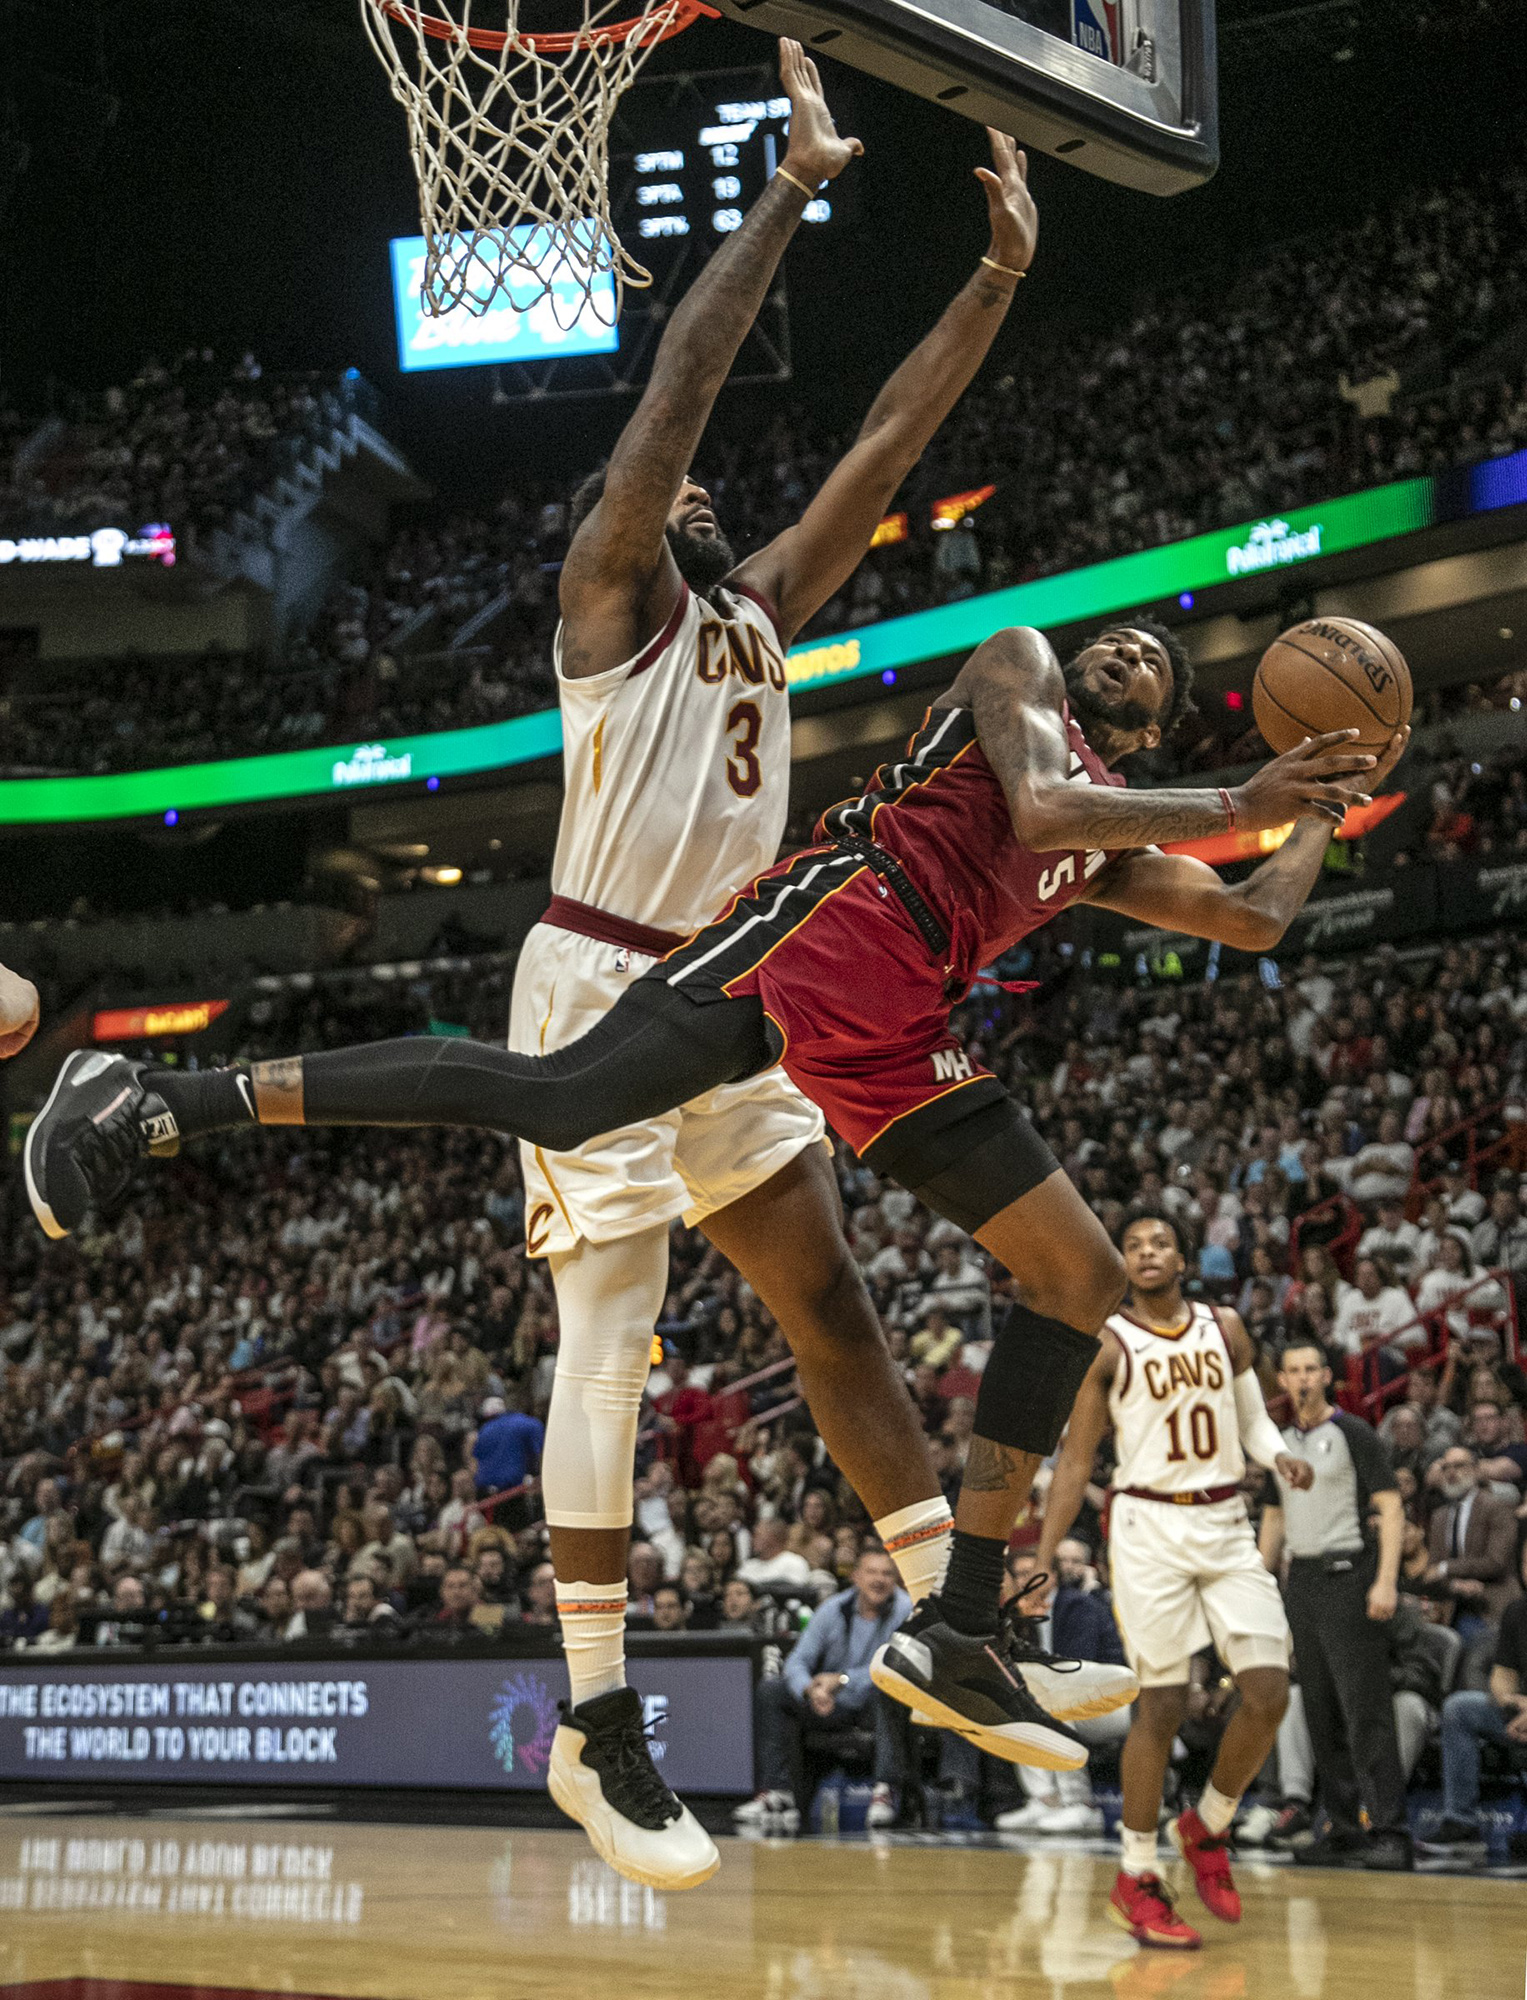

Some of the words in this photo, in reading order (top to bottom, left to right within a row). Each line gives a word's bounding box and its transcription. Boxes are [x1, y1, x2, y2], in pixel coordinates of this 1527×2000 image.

[1078, 20, 1104, 57] NBA
[726, 699, 764, 799] 3
[1037, 854, 1076, 902] 5
[529, 1202, 554, 1254] C
[1143, 1349, 1225, 1401] CAVS
[1165, 1402, 1219, 1462] 10
[0, 1683, 38, 1718] THE
[40, 1682, 170, 1718] ECOSYSTEM
[173, 1681, 235, 1718] THAT
[237, 1680, 369, 1718] CONNECTS
[24, 1726, 67, 1761] THE
[70, 1726, 150, 1761] WORLD
[153, 1726, 185, 1761] TO
[187, 1726, 250, 1761] YOUR
[254, 1726, 338, 1762] BLOCK
